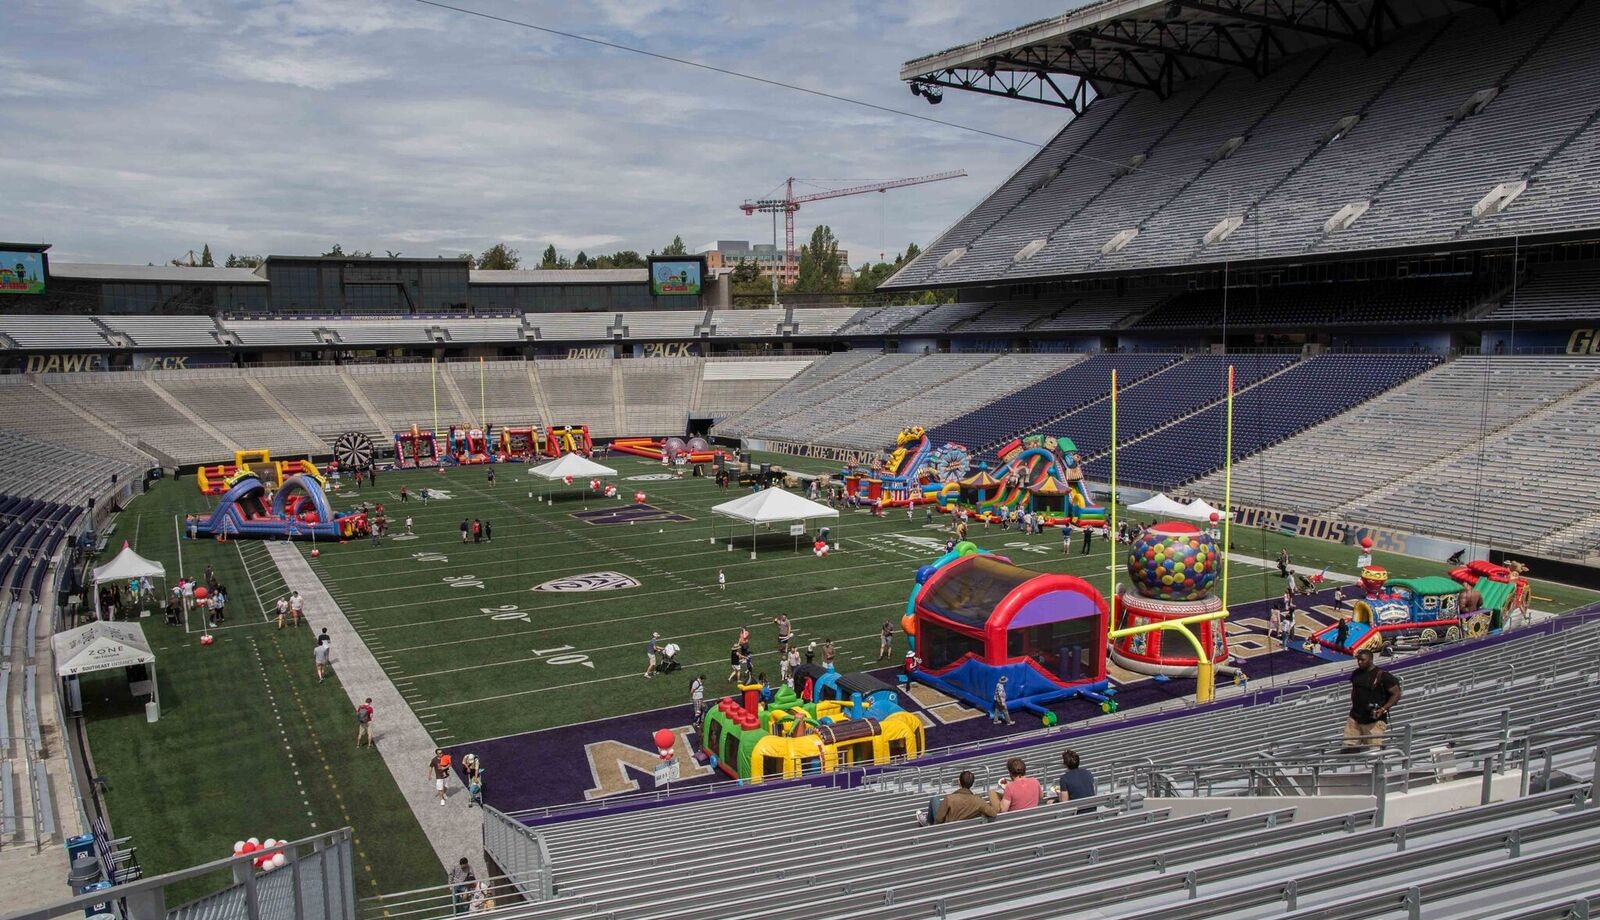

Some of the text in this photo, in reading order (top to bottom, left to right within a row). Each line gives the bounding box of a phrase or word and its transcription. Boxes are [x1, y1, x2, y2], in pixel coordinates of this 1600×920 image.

[565, 342, 693, 360] DAWG PACK
[25, 353, 101, 374] DAWG
[765, 440, 803, 457] MIGHTY
[805, 445, 829, 460] ARE
[831, 448, 855, 463] THE
[480, 604, 529, 621] 20
[88, 645, 124, 656] ZONE
[532, 645, 589, 665] 10
[82, 663, 110, 672] SOUTHEAST
